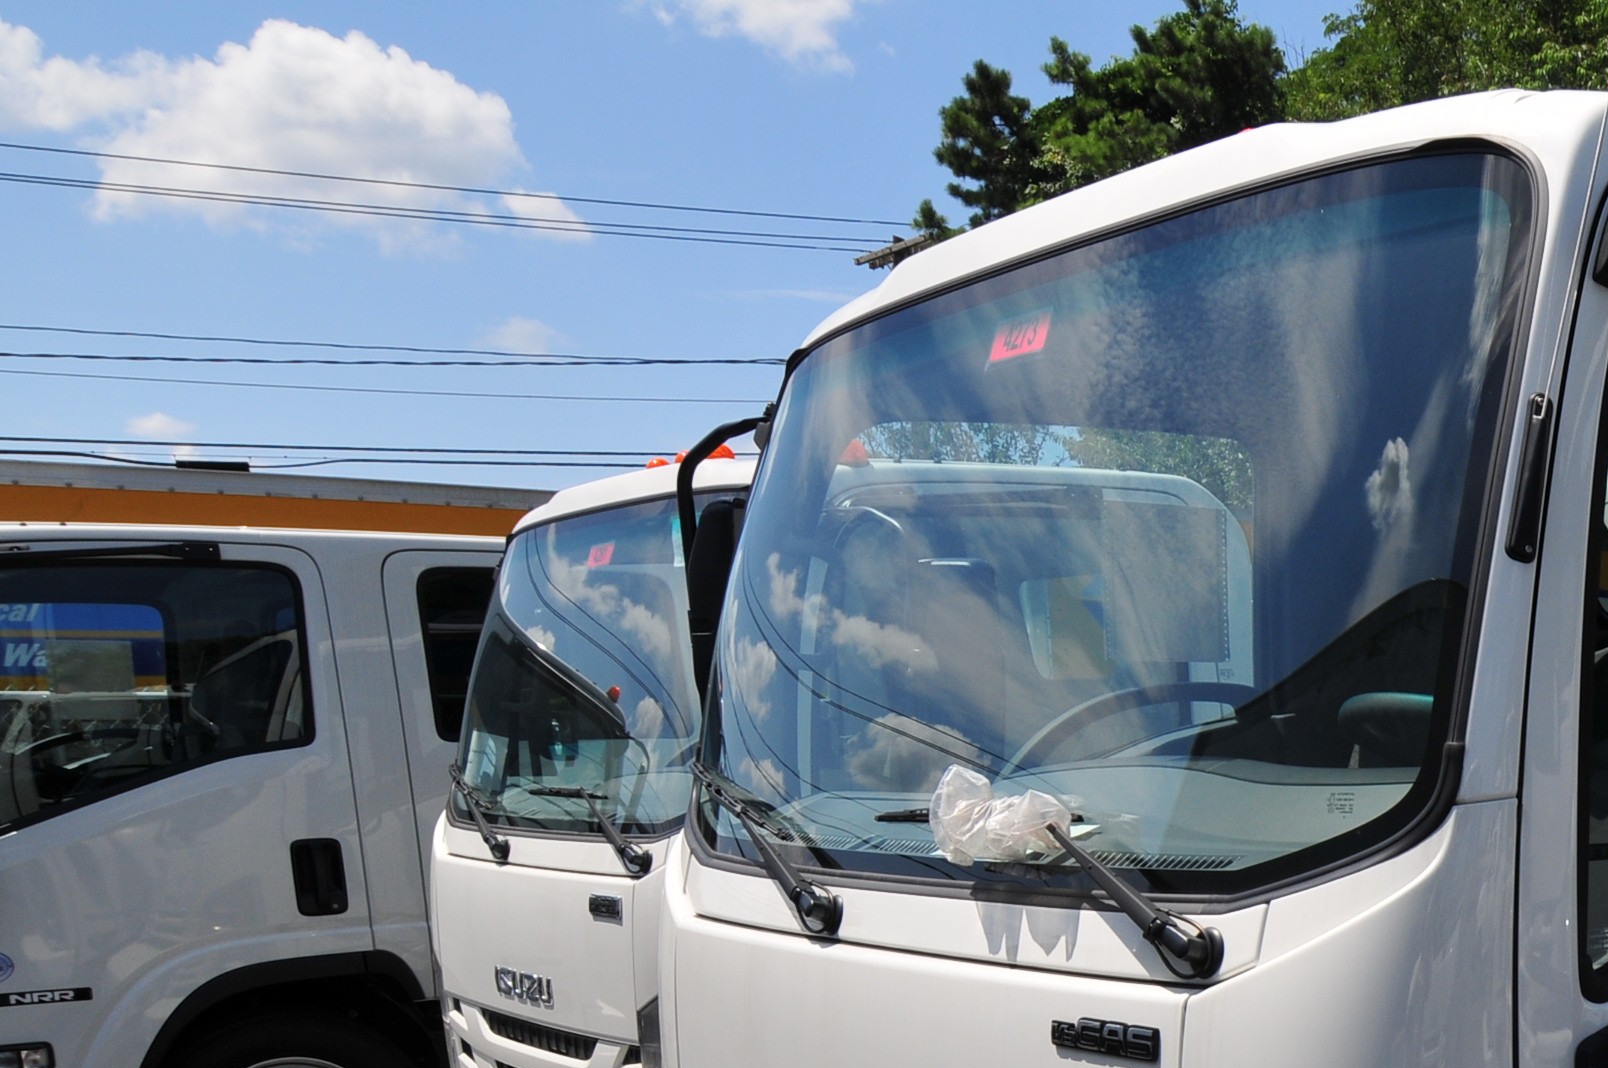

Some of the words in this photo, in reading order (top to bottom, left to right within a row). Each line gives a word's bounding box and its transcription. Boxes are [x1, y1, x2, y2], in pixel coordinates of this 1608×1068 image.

[9, 989, 77, 1005] NRR
[494, 964, 553, 1006] ISUZU
[1077, 1019, 1154, 1060] GAS
